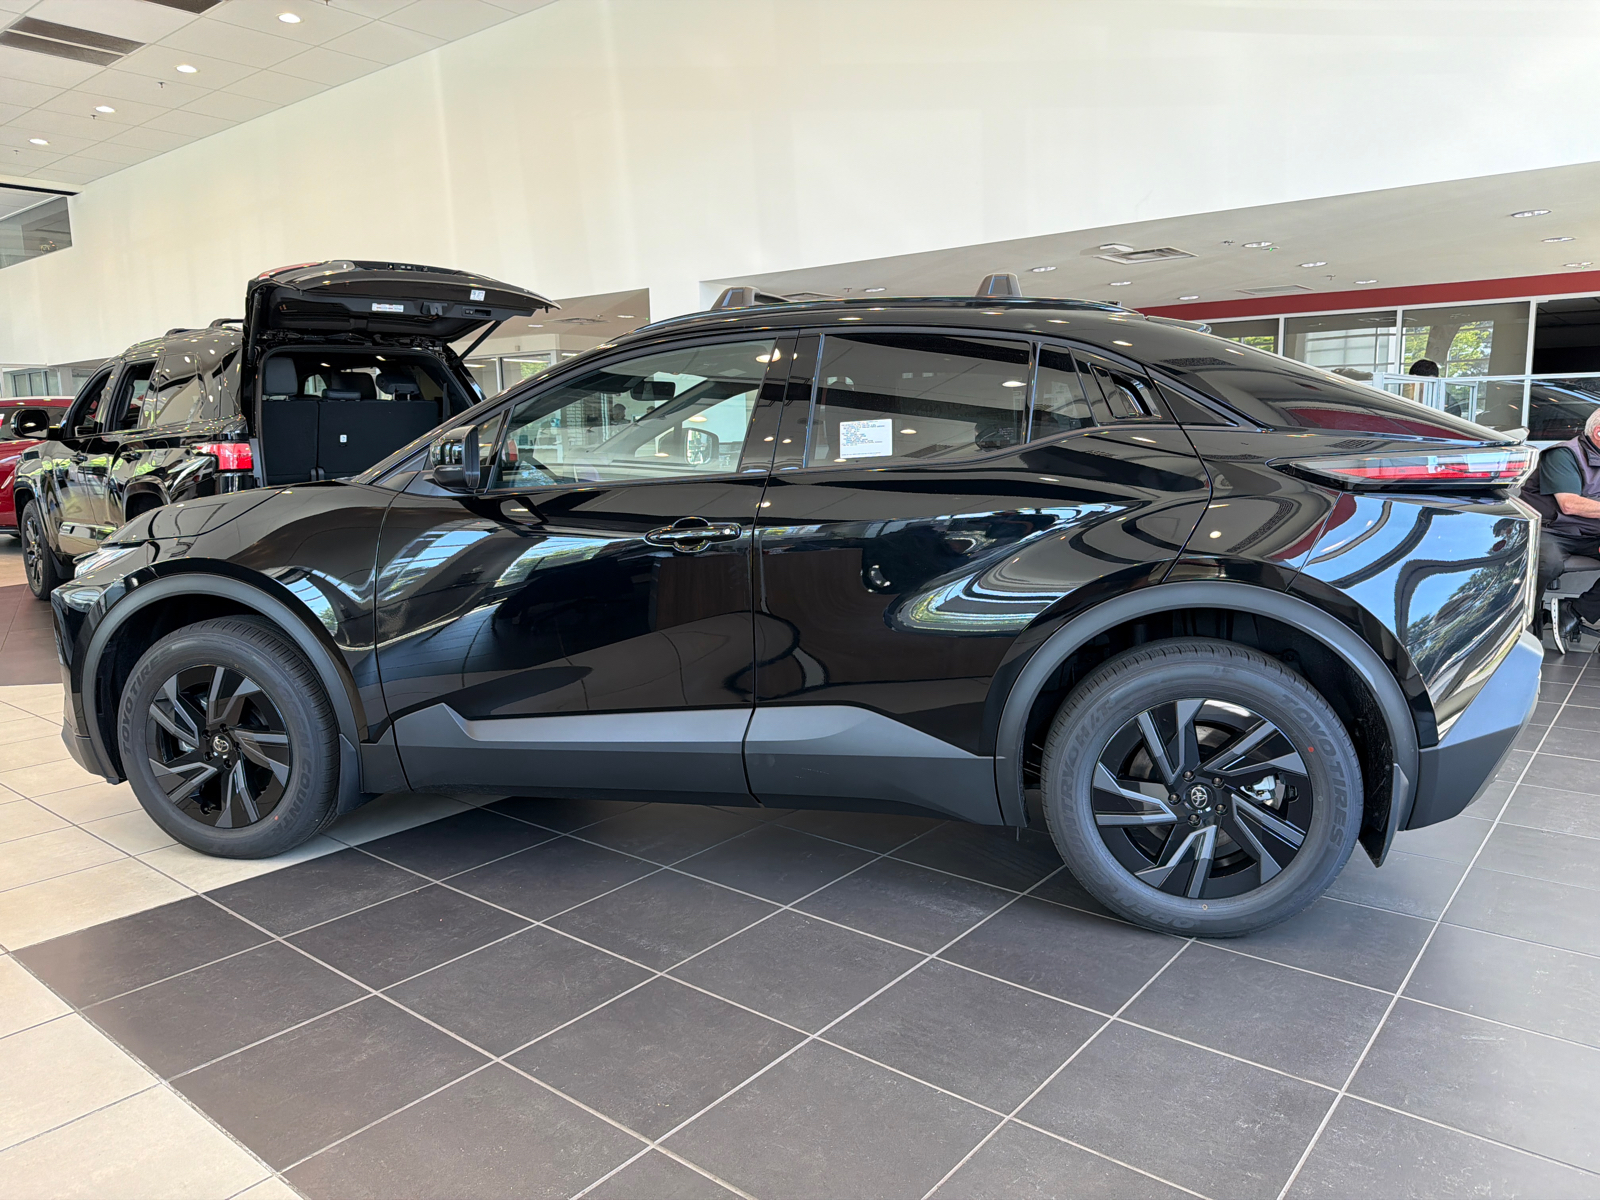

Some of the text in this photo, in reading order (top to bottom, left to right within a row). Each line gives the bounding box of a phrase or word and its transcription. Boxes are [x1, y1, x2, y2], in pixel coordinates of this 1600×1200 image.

[122, 696, 133, 755] TOYO
[1282, 694, 1347, 847] TOYO TIRES
[1118, 896, 1195, 928] OPEN
